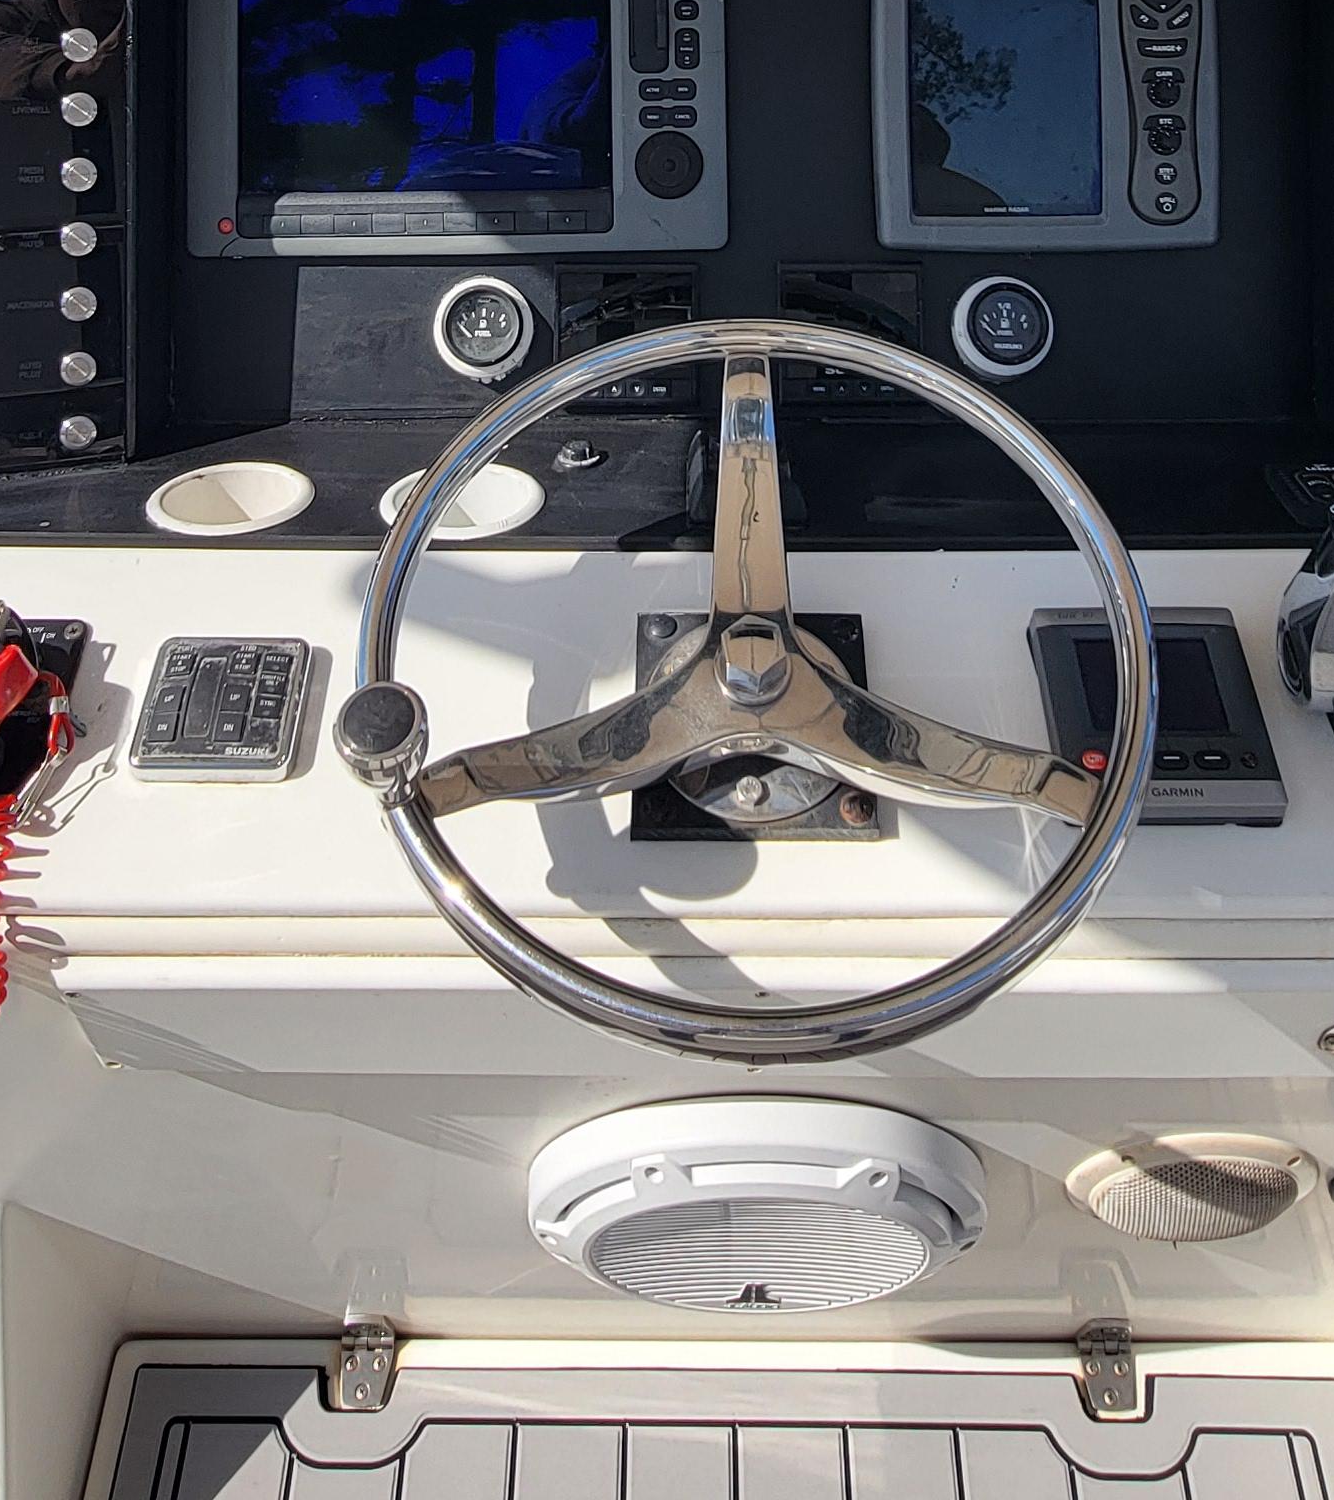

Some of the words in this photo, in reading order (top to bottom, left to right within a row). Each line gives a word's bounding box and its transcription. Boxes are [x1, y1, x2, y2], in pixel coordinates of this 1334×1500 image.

[266, 655, 289, 663] SELECT
[164, 694, 175, 704] UP
[230, 693, 241, 702] UP
[157, 723, 169, 732] DN
[223, 723, 235, 732] DN
[224, 745, 270, 756] SUZUKI
[1151, 787, 1205, 798] GARMIN
